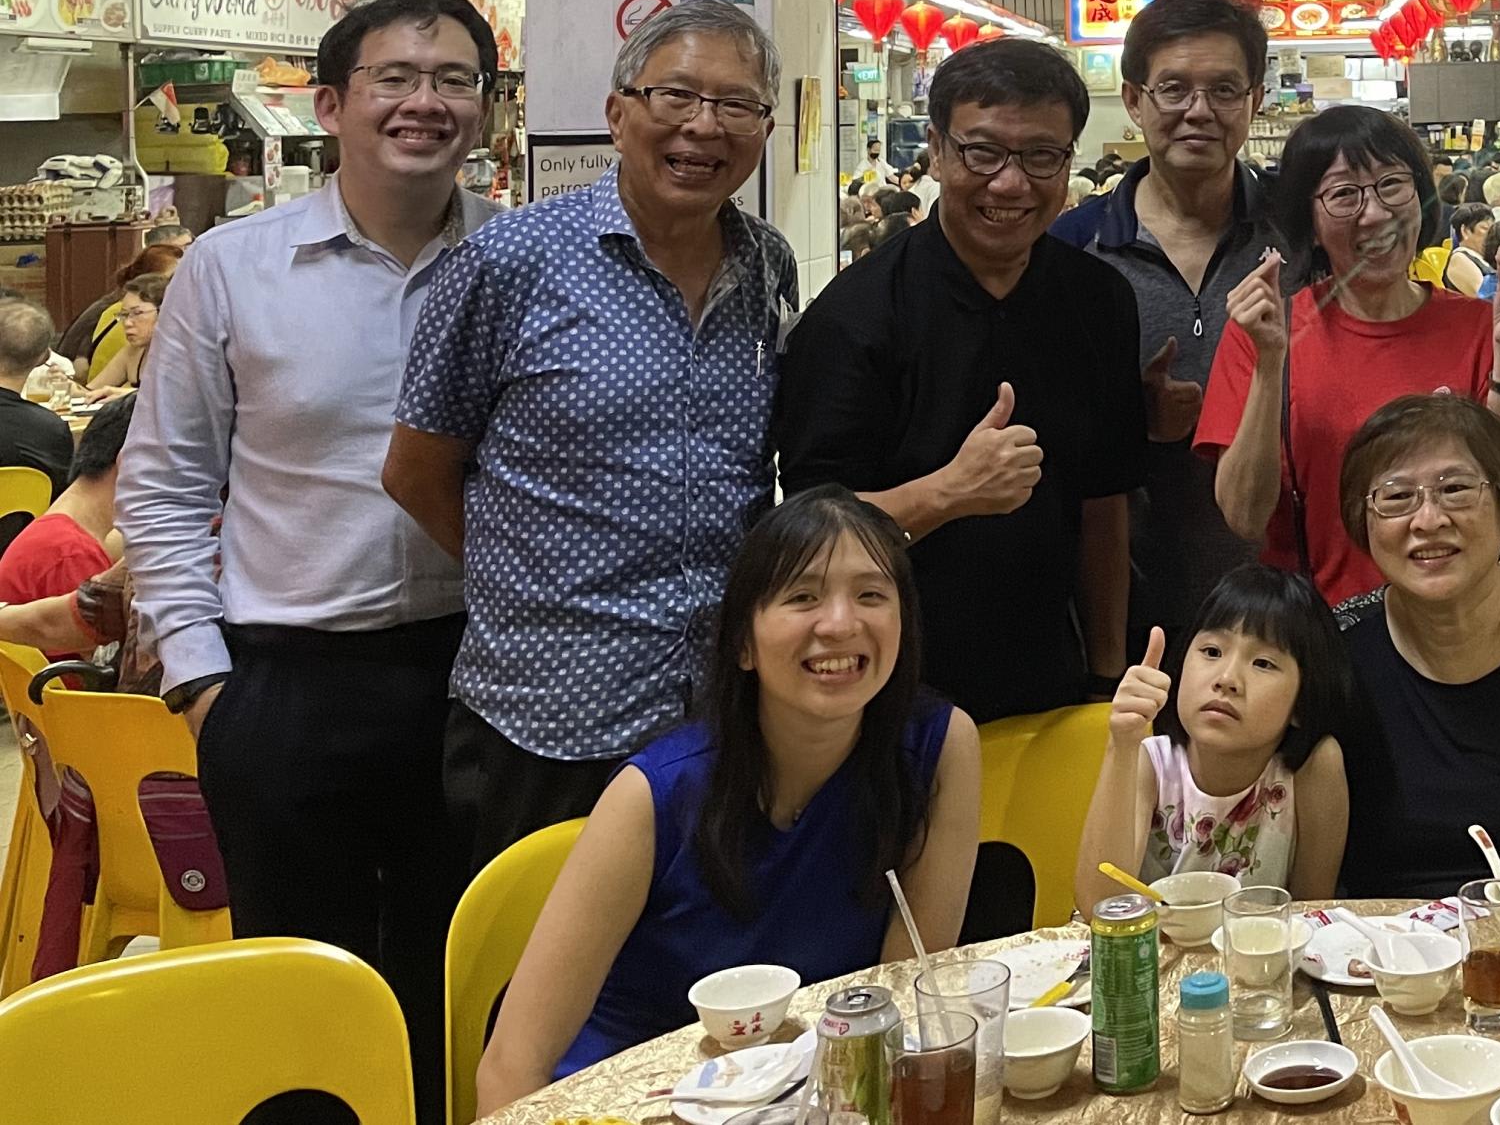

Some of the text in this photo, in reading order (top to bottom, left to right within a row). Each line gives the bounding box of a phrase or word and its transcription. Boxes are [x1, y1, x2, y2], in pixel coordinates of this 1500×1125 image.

[152, 22, 232, 39] SUPPLY CURRY PASTE
[246, 30, 268, 42] MIXED
[540, 154, 613, 173] Only fully
